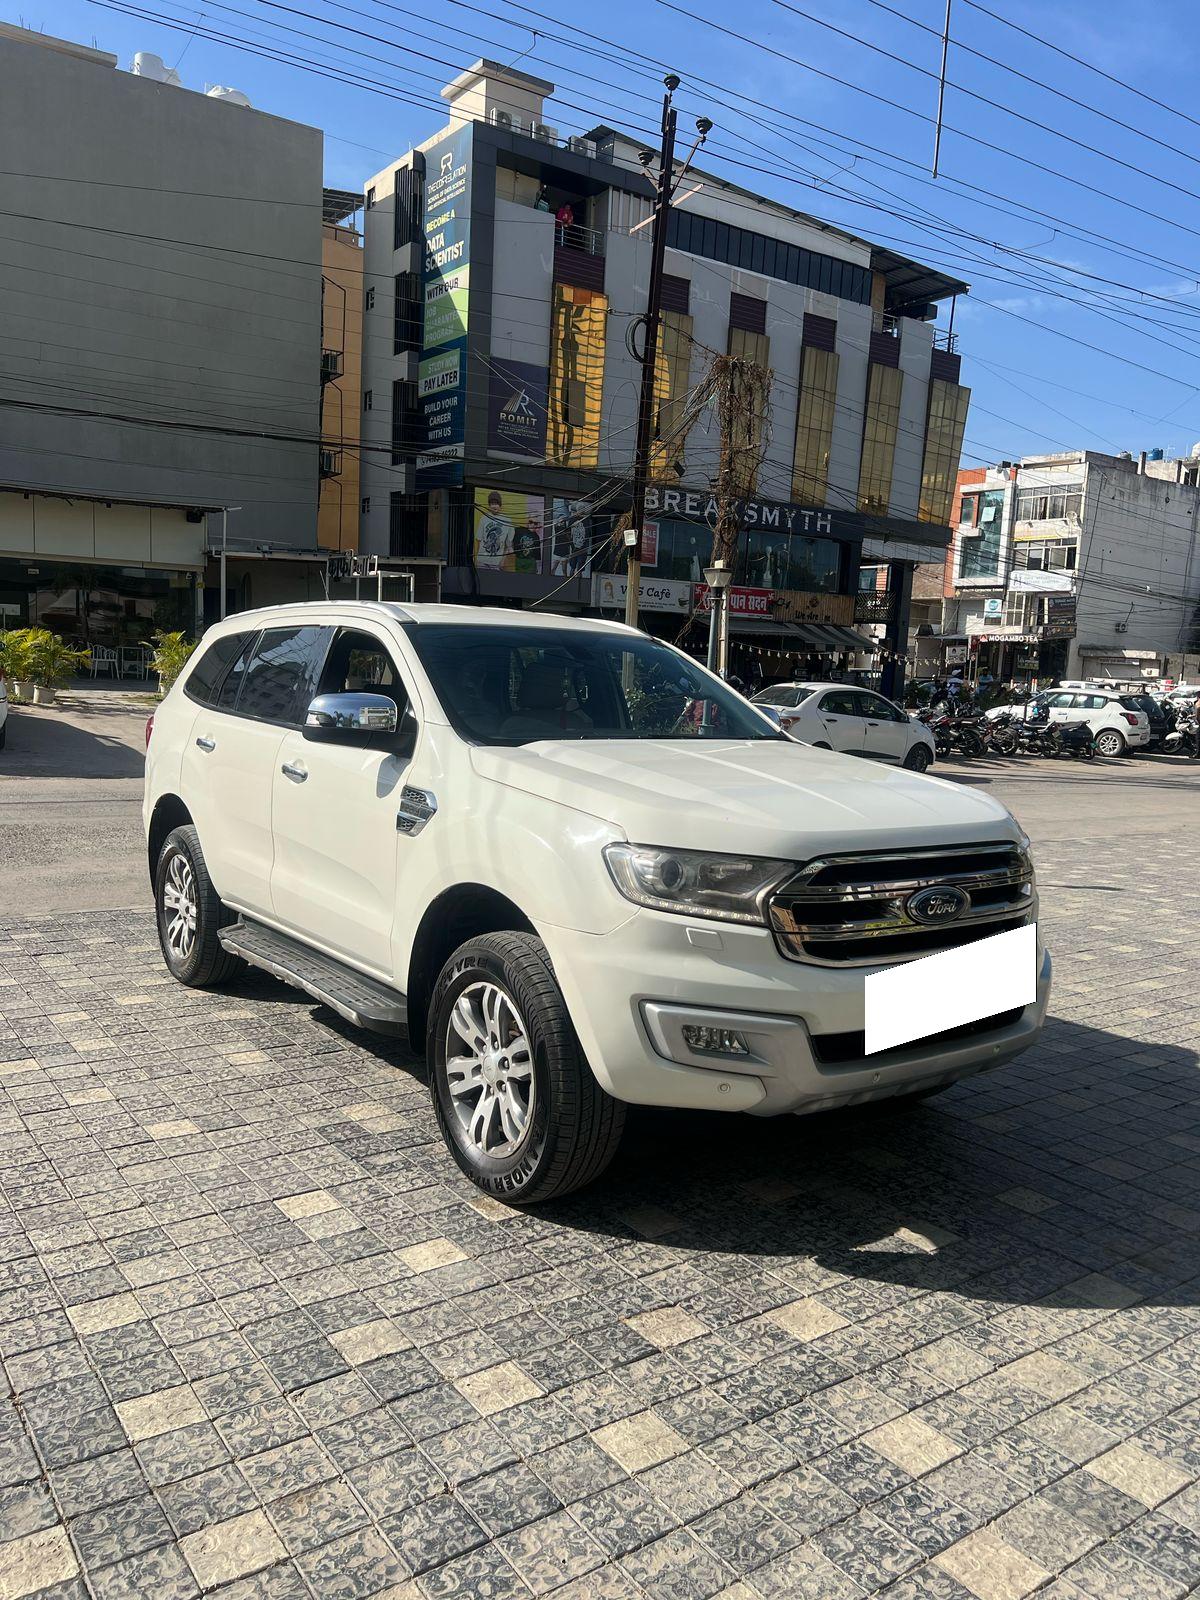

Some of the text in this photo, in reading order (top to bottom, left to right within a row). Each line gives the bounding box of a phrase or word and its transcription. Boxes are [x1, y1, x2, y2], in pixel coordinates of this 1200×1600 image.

[426, 208, 456, 233] BECOME A
[426, 232, 445, 255] DATA
[425, 240, 464, 273] SCIENTIST
[427, 277, 459, 301] WITH OUR
[423, 371, 458, 392] PAY LATER
[424, 396, 458, 413] BUILD YOUR
[429, 412, 452, 427] CAREER
[500, 412, 538, 426] ROMIT
[428, 426, 452, 441] WITH US
[988, 634, 1024, 643] MOGAMBO
[1024, 634, 1039, 644] TEA
[927, 894, 958, 915] Ford
[446, 955, 489, 983] TYRE
[492, 1122, 545, 1193] RANGER
